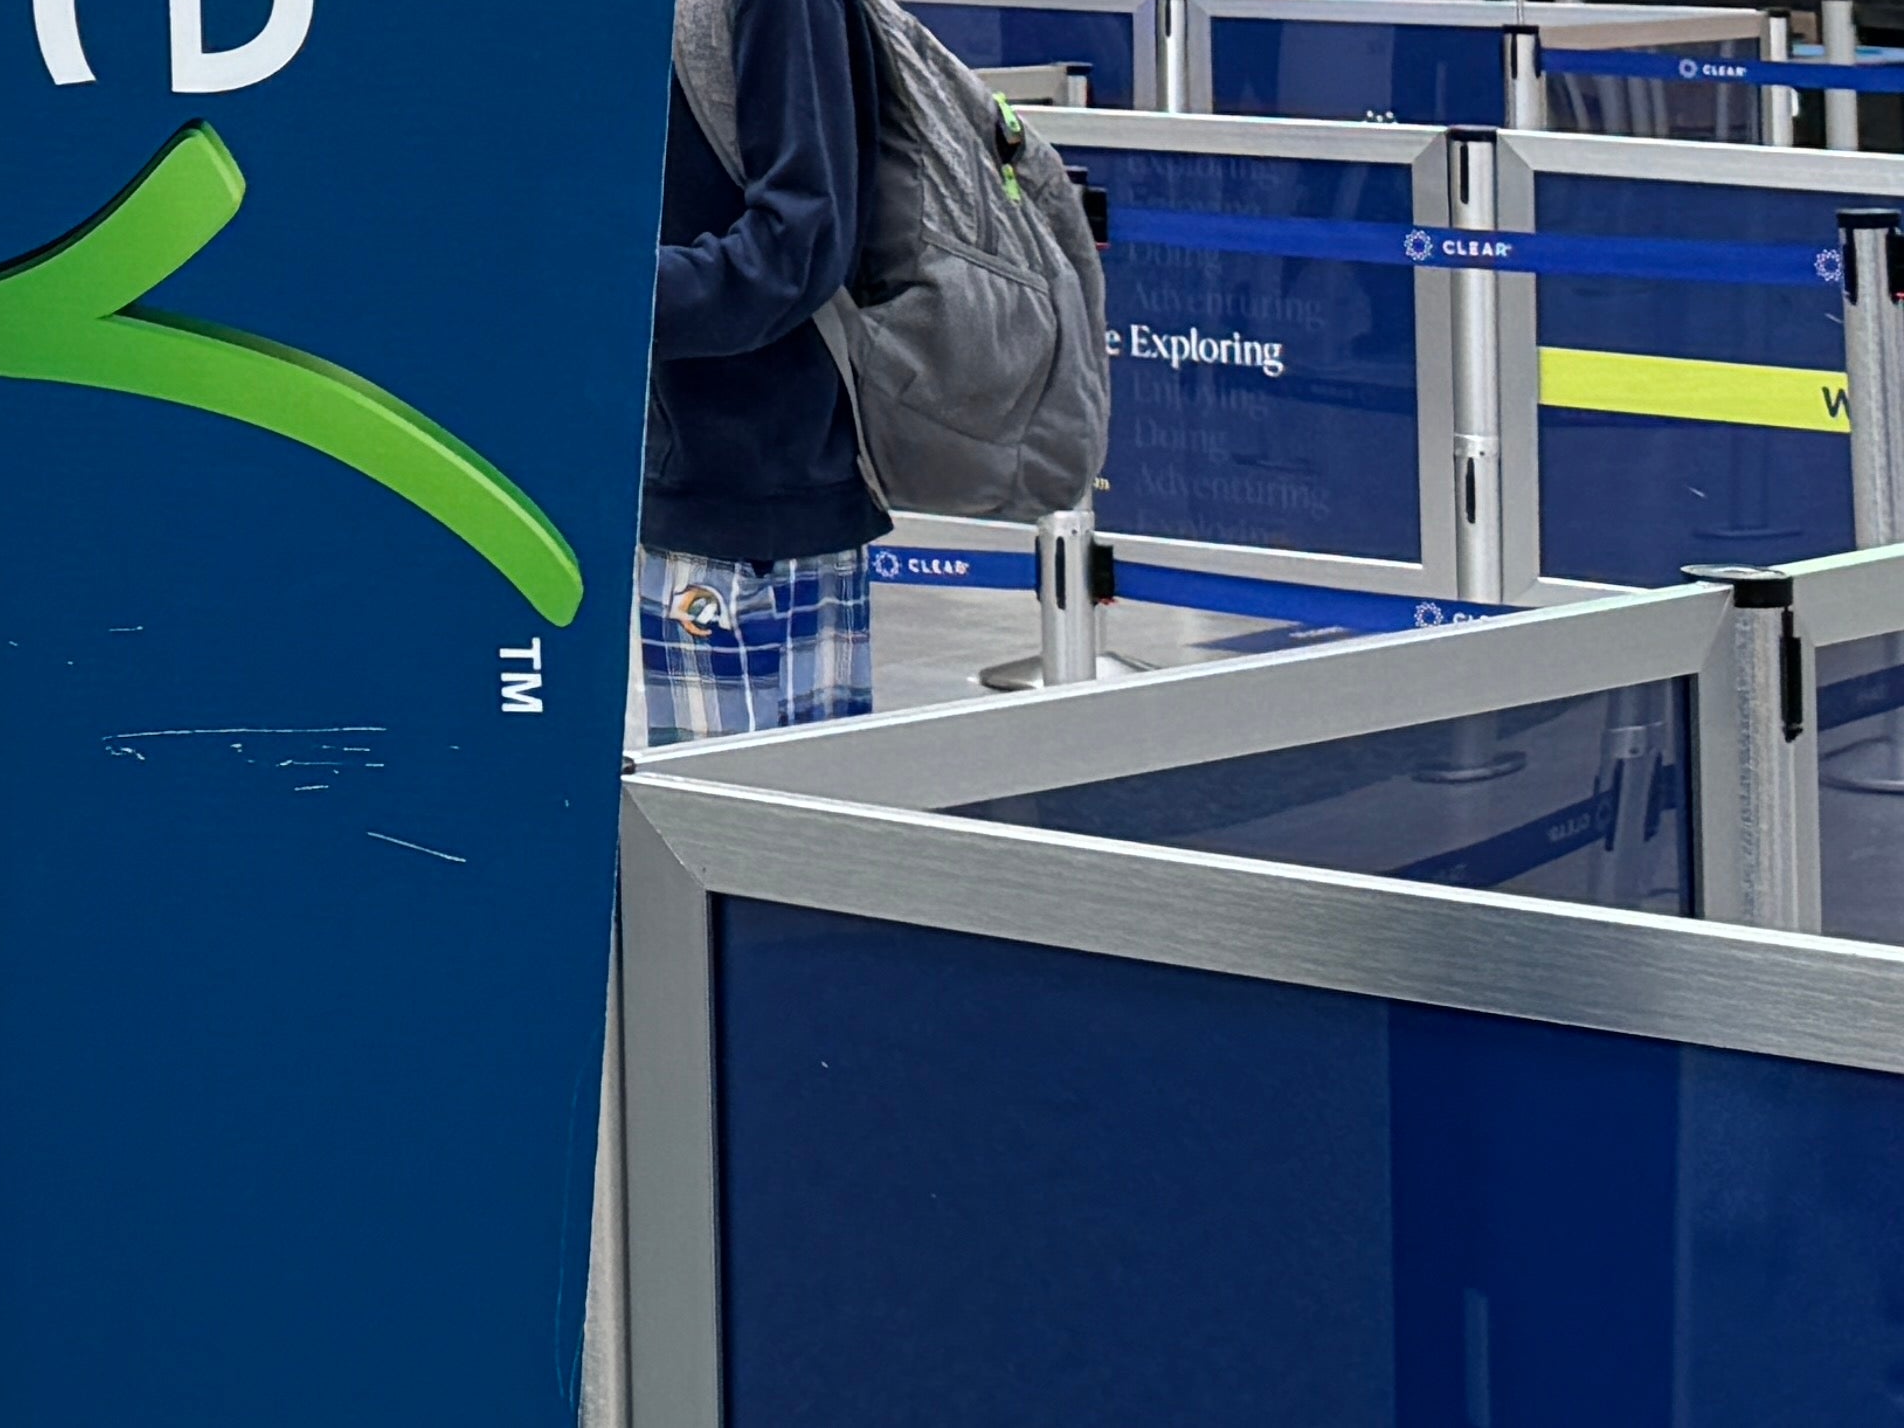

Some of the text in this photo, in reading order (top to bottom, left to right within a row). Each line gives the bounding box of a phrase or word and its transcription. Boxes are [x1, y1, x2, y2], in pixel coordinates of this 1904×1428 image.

[1701, 63, 1746, 77] CLEAR
[1442, 238, 1511, 258] CLEAR
[1130, 324, 1287, 378] Exploring
[908, 557, 969, 575] CLEAR
[499, 636, 544, 714] TM
